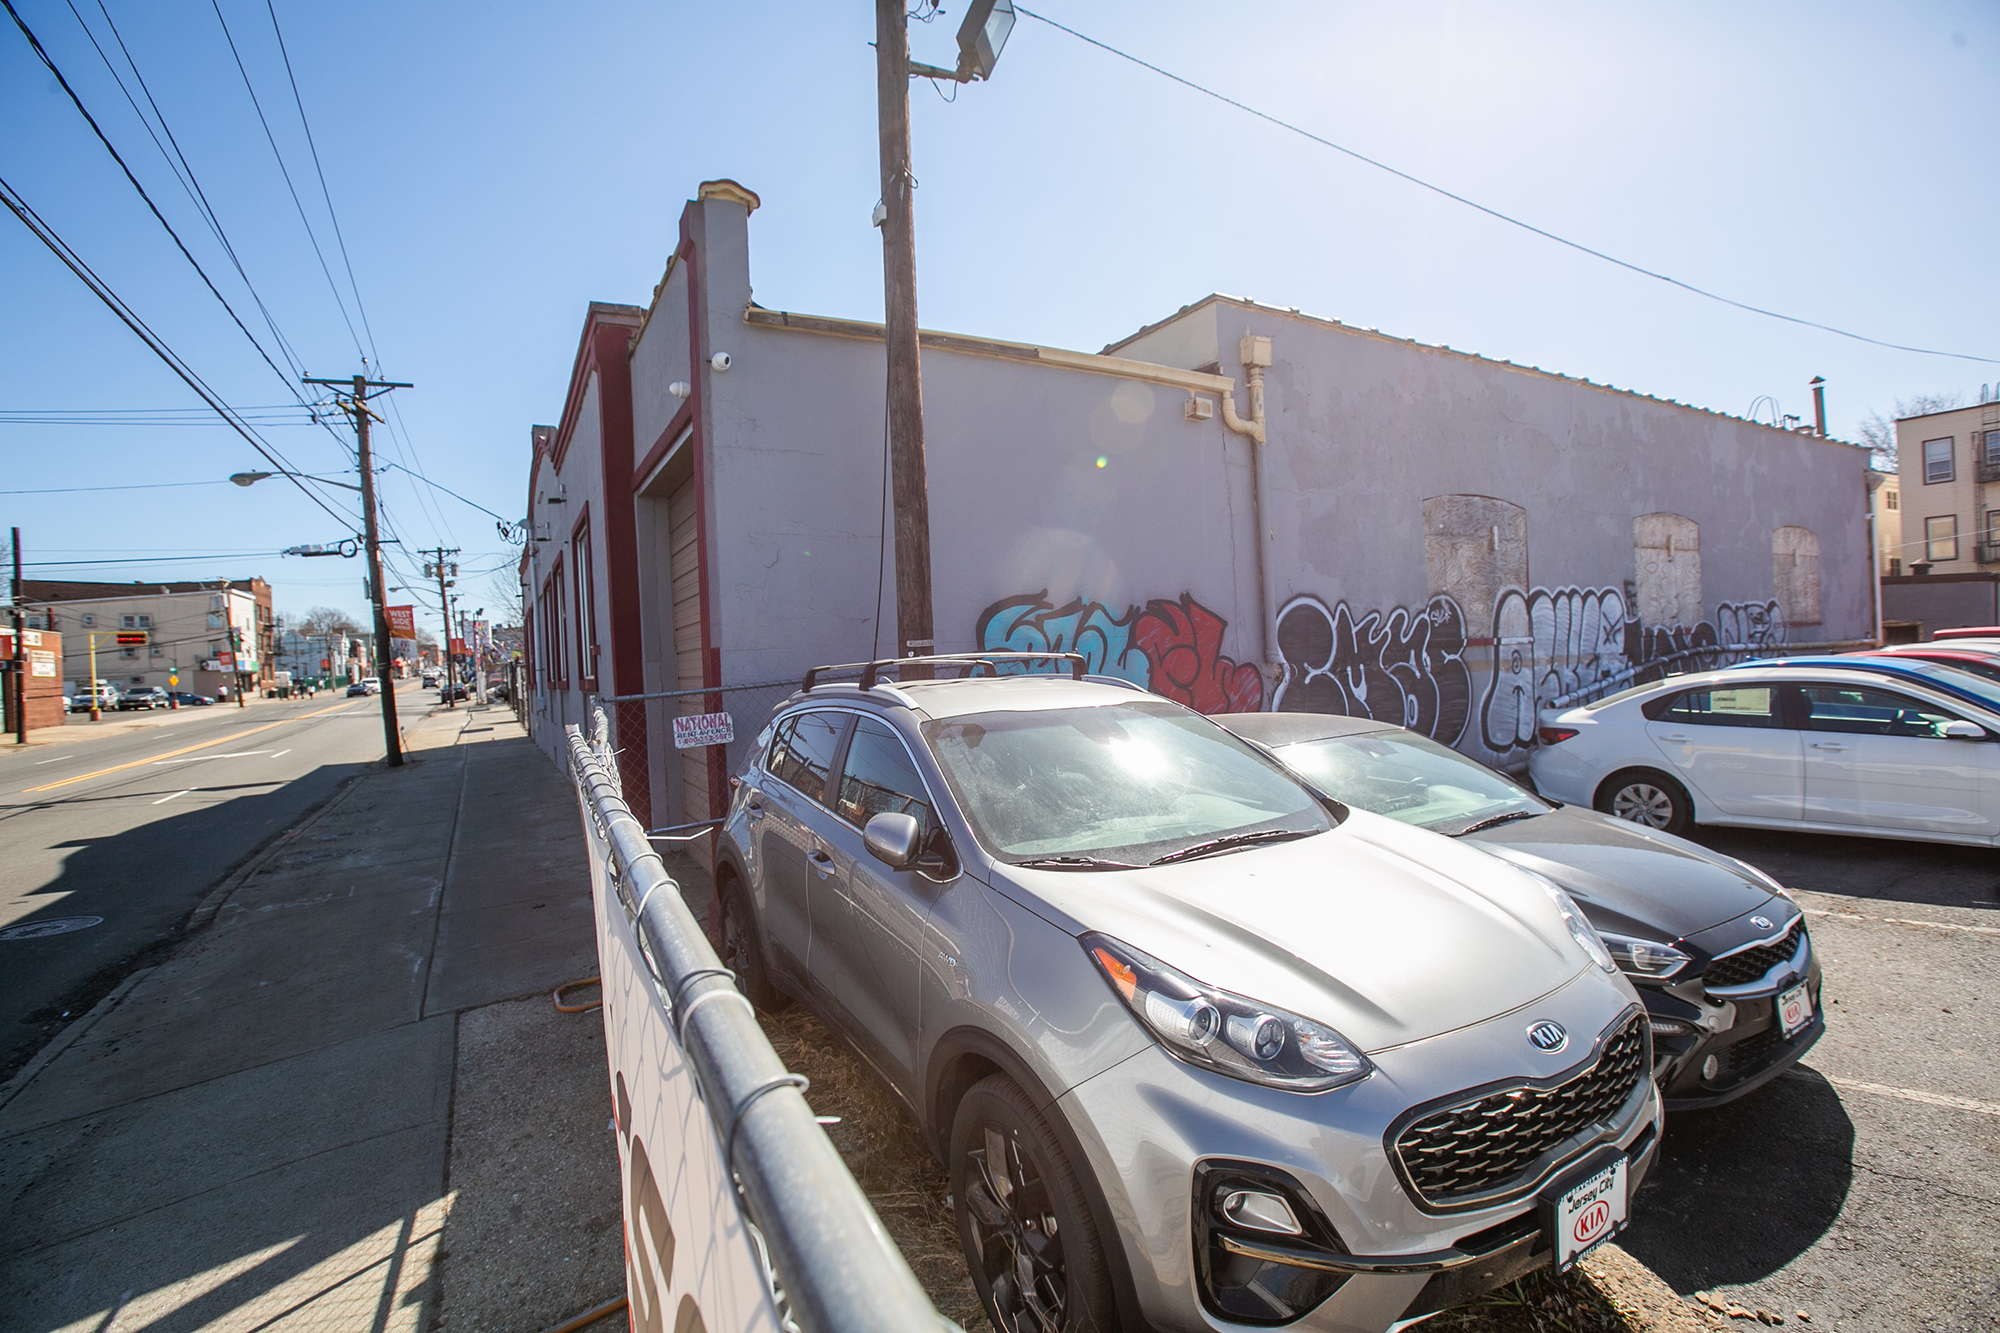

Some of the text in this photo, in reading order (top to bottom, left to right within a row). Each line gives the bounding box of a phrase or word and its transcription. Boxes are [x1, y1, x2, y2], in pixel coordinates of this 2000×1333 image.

[391, 617, 412, 625] SIDE
[675, 713, 731, 733] NATIONAL
[1786, 1006, 1800, 1020] KIA
[1531, 1024, 1563, 1047] KIA
[1568, 1176, 1615, 1214] Jersey City
[1580, 1206, 1604, 1237] KIA
